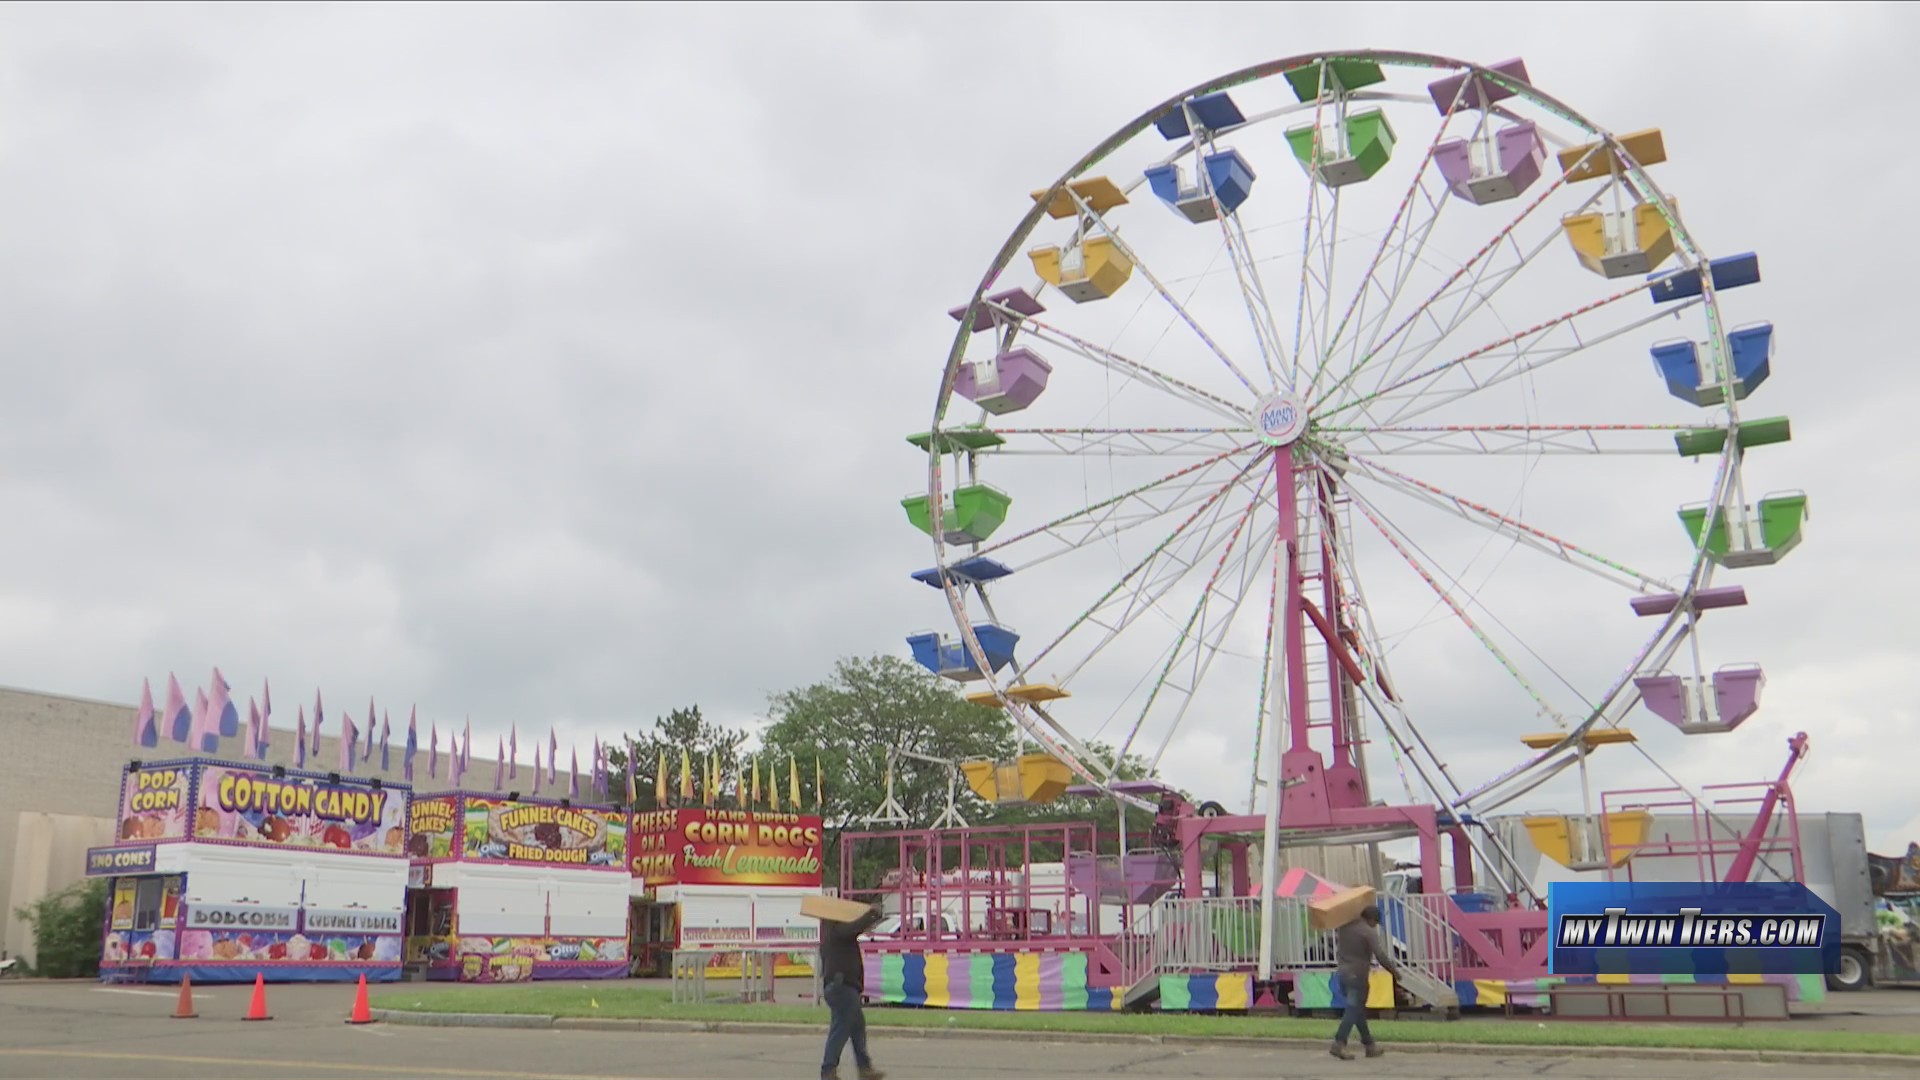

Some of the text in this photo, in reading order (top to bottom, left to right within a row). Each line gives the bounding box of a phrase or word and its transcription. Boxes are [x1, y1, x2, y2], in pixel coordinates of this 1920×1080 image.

[1264, 405, 1293, 421] MAIN
[140, 770, 176, 790] POP
[131, 789, 179, 812] CORN
[219, 776, 385, 827] COTTON CANDY
[411, 801, 451, 819] UNNEL
[411, 817, 446, 834] CAKES
[500, 806, 598, 840] FUNNEL CAKES
[631, 809, 678, 834] CHEESE
[705, 809, 800, 824] HAND DIPPED
[641, 833, 666, 851] ON A
[684, 821, 819, 847] CORN DOGS
[91, 850, 152, 868] SNO CONES
[508, 842, 588, 863] FRIED DOUGH
[683, 844, 820, 876] Fresh Lemonade
[631, 853, 676, 877] STICK
